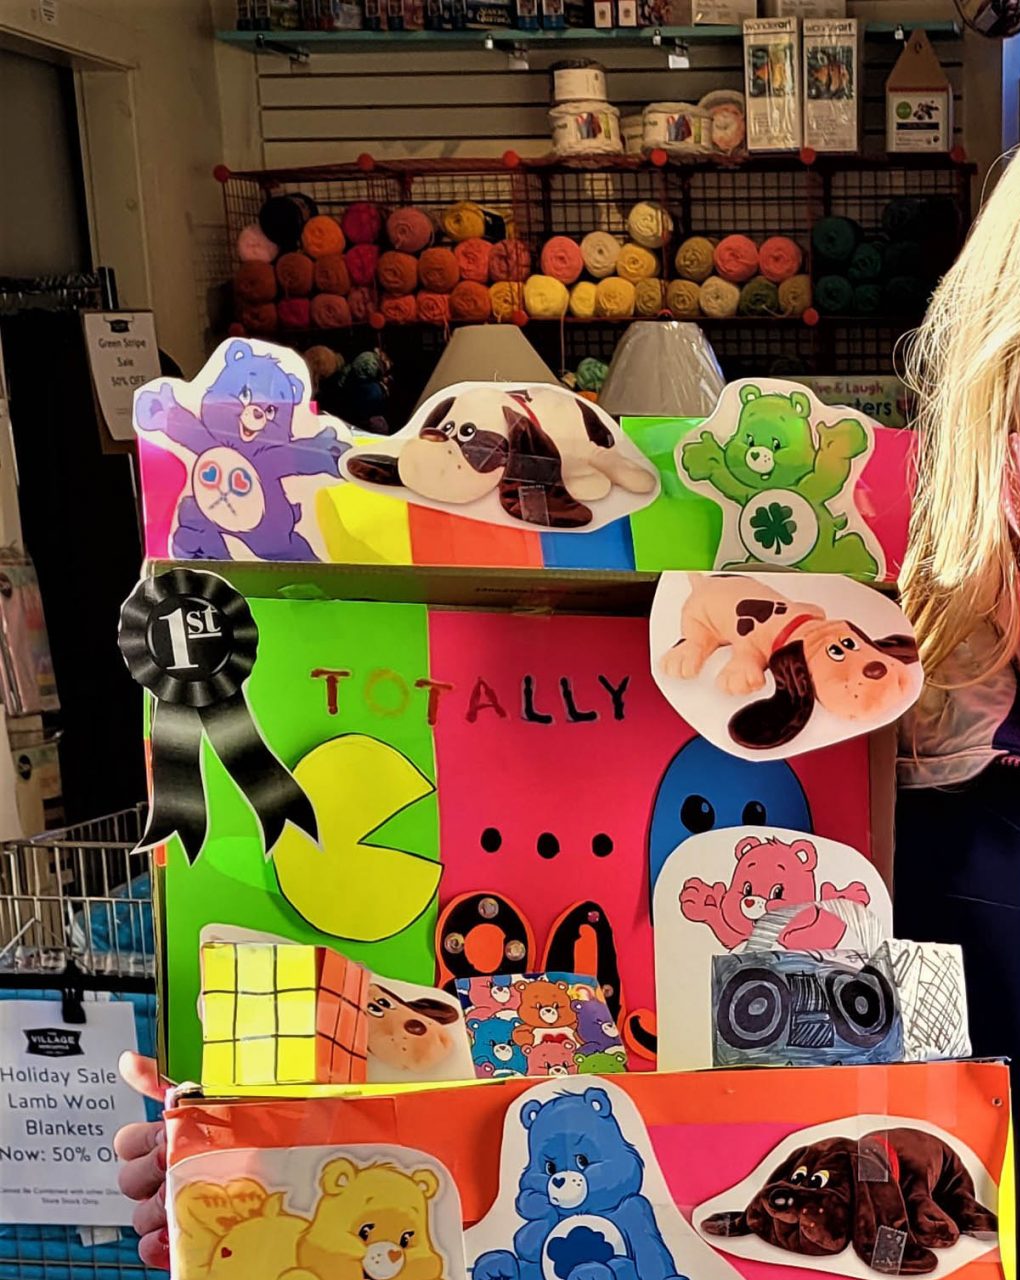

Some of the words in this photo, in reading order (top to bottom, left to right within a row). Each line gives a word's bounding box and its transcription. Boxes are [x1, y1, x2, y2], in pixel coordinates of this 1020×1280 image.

[846, 383, 884, 395] Laugh
[158, 605, 222, 670] 1st
[310, 668, 630, 726] TOTALLY
[31, 1035, 75, 1045] VILLAGE
[0, 1067, 71, 1087] Holiday
[77, 1068, 116, 1084] Sale
[8, 1093, 58, 1109] Lamb
[63, 1094, 115, 1110] Wool
[26, 1119, 104, 1136] Blankets
[0, 1147, 46, 1162] Now:
[53, 1147, 91, 1162] 50%
